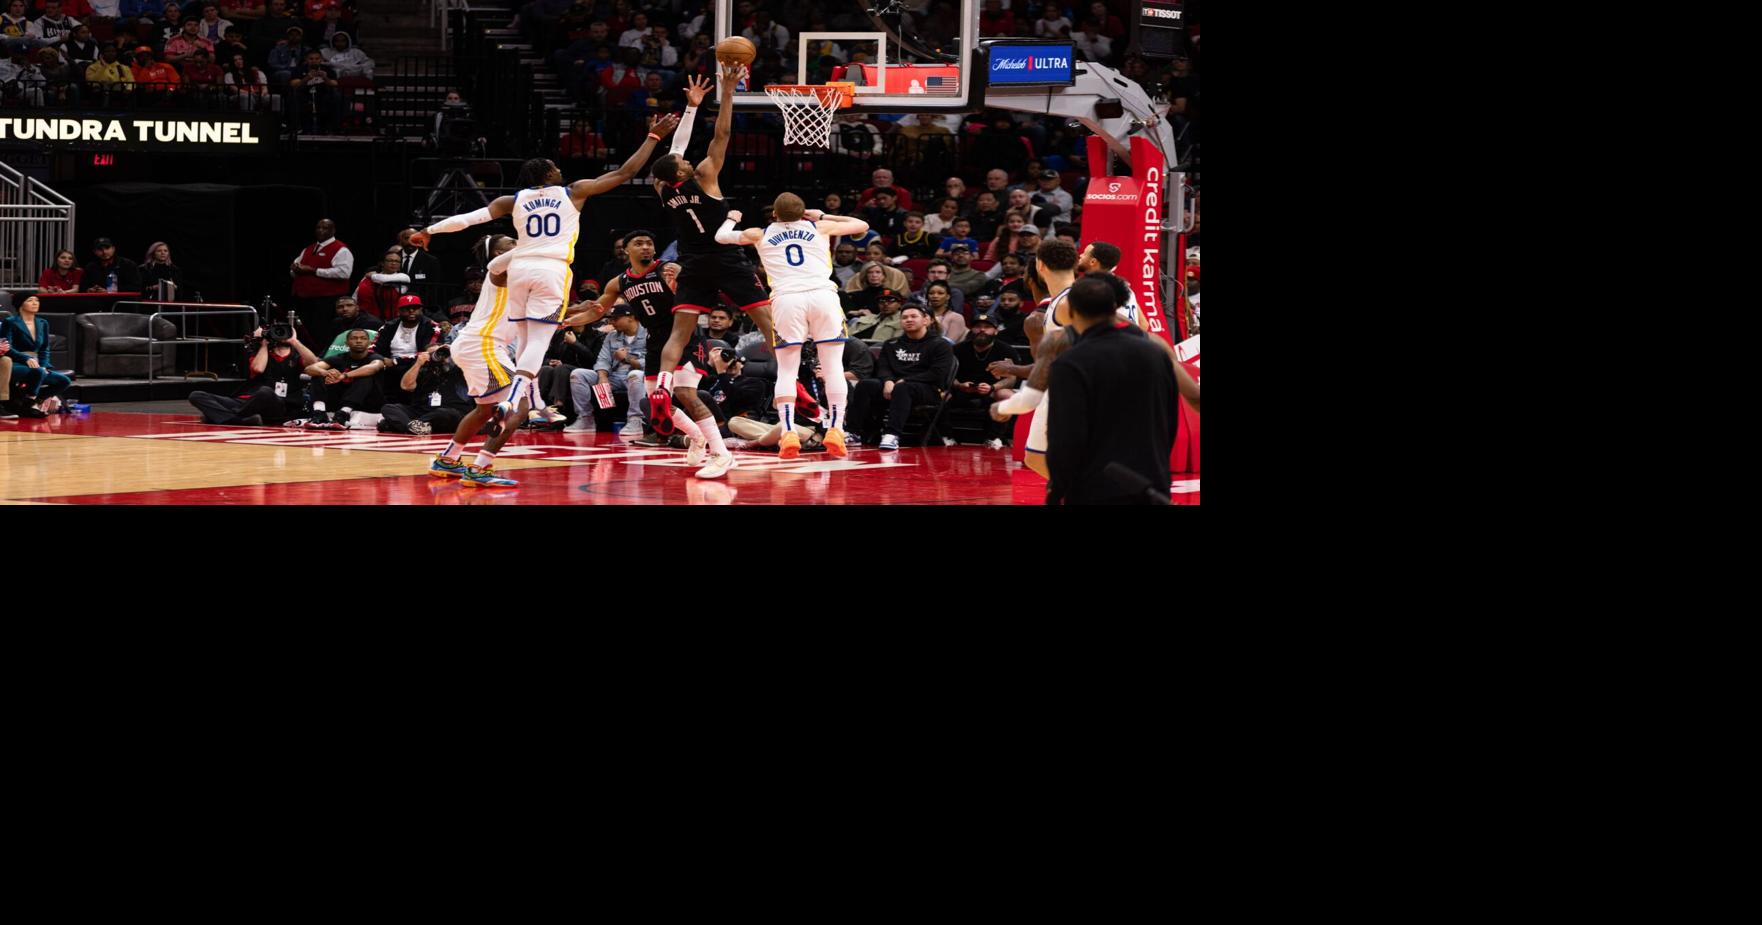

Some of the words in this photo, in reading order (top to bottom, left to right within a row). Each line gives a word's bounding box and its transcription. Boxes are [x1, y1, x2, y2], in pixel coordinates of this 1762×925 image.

[1153, 9, 1182, 19] TISSOT
[992, 58, 1028, 71] Michelob
[1035, 57, 1068, 69] ULTRA
[0, 118, 127, 141] TUNDRA
[133, 120, 259, 143] TUNNEL
[523, 198, 561, 212] KUMINGA
[690, 195, 702, 204] JR.
[1144, 167, 1160, 242] credit
[526, 213, 560, 237] 00
[686, 208, 705, 233] 1
[768, 230, 815, 246] DIVINCENZO
[785, 244, 804, 266] 0
[624, 281, 664, 302] HOUSTON
[1142, 248, 1163, 333] karma
[641, 299, 656, 316] 6
